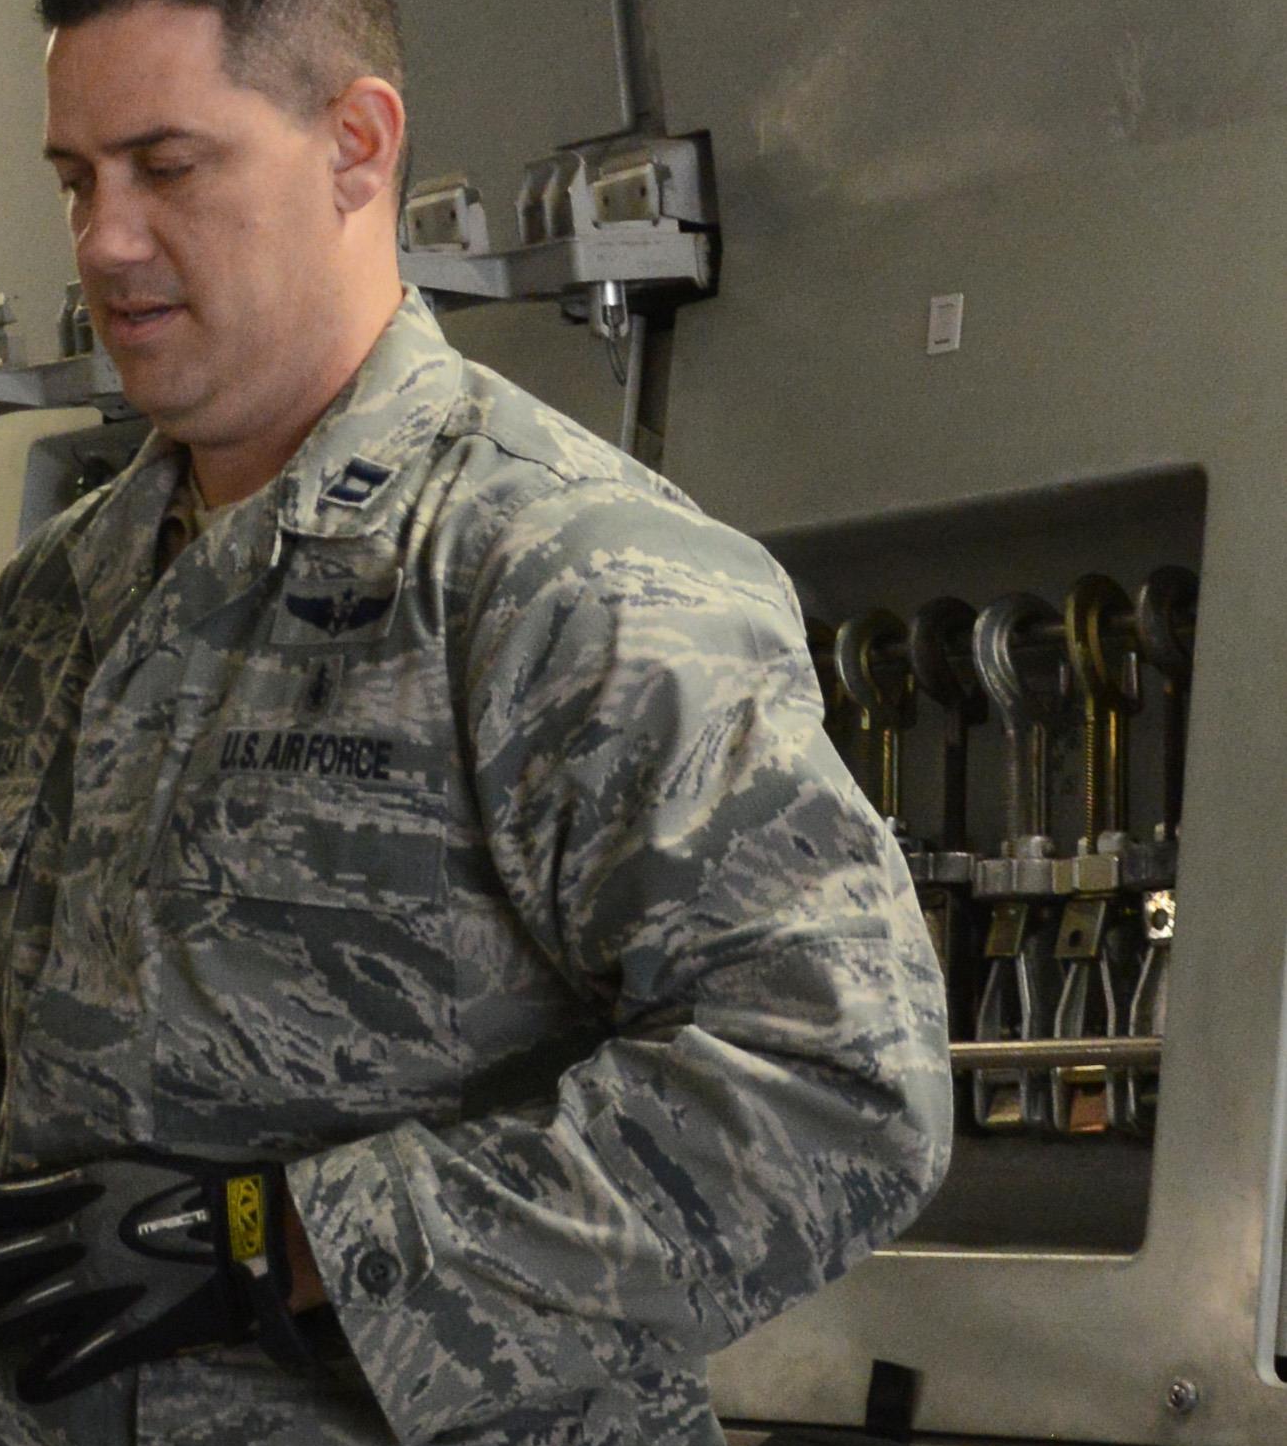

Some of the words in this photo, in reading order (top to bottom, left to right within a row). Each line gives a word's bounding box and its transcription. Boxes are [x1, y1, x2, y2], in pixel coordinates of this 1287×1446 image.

[220, 731, 260, 772] U.S.
[263, 731, 308, 774] AIR
[305, 733, 393, 781] FORCE
